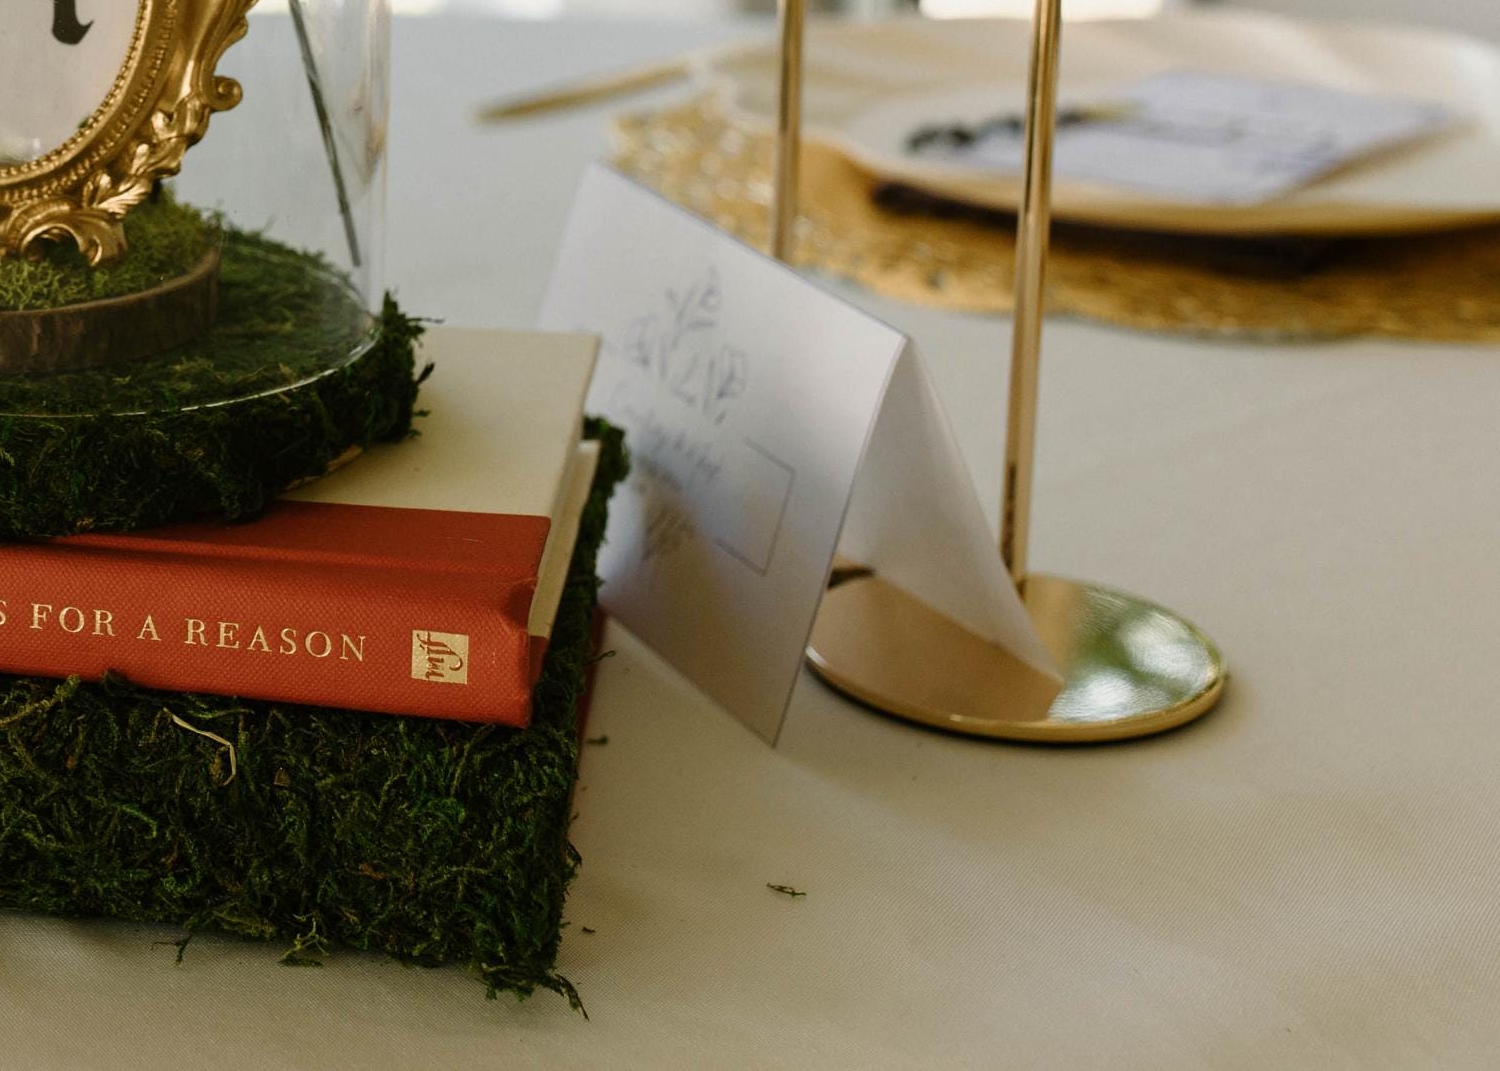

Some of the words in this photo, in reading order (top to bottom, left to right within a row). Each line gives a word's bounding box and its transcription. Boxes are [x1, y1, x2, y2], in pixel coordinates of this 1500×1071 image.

[29, 602, 116, 637] FOR
[136, 614, 162, 642] A
[184, 617, 367, 662] REASON
